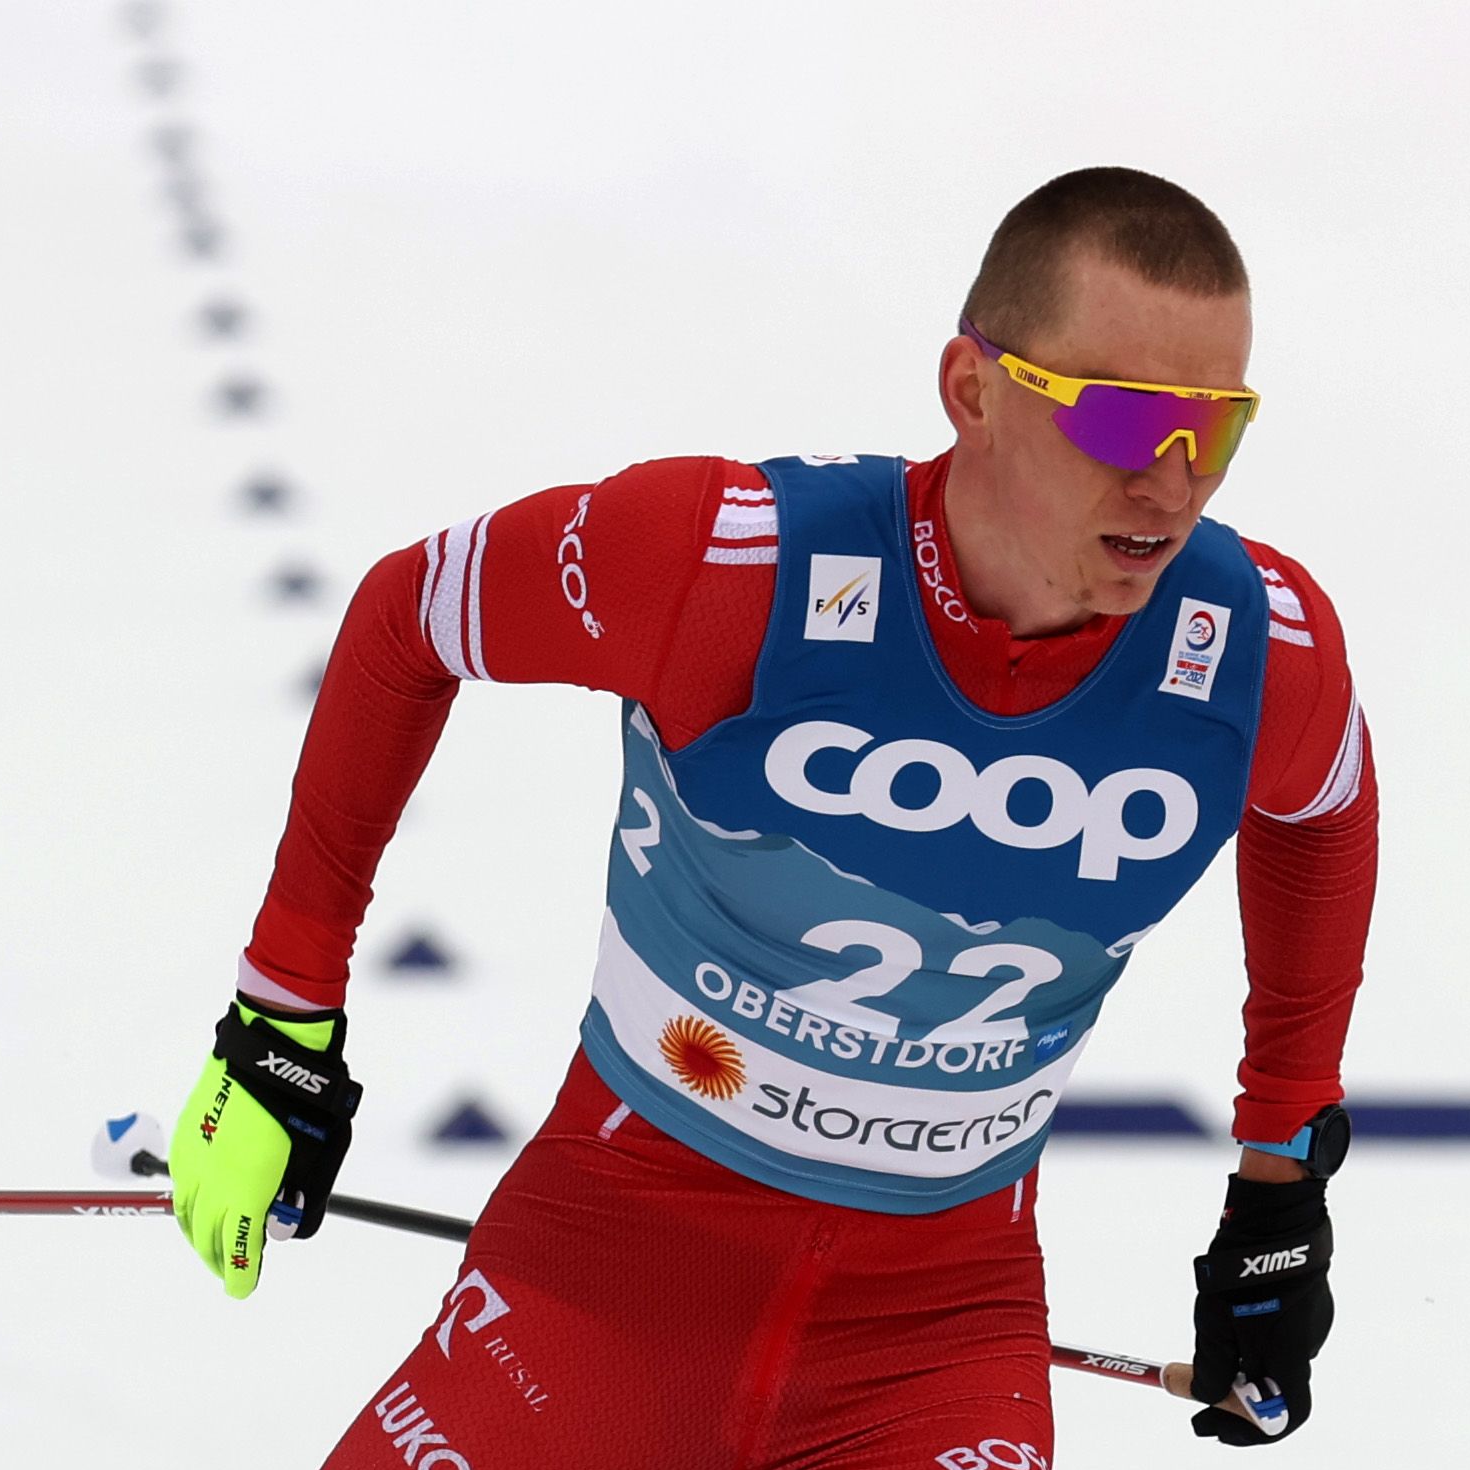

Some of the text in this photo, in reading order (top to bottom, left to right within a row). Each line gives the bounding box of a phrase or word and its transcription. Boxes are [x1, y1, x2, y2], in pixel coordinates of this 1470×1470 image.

[557, 486, 596, 609] SCO
[913, 520, 968, 622] BOSCO
[814, 598, 868, 616] FIS
[764, 720, 1199, 881] coop
[694, 961, 1027, 1073] OBERSTDORF
[773, 919, 1064, 1044] 22
[256, 1051, 330, 1095] SWIX
[1238, 1244, 1310, 1278] SWIX
[484, 1337, 549, 1413] RUSAL
[1080, 1354, 1150, 1376] SWIX
